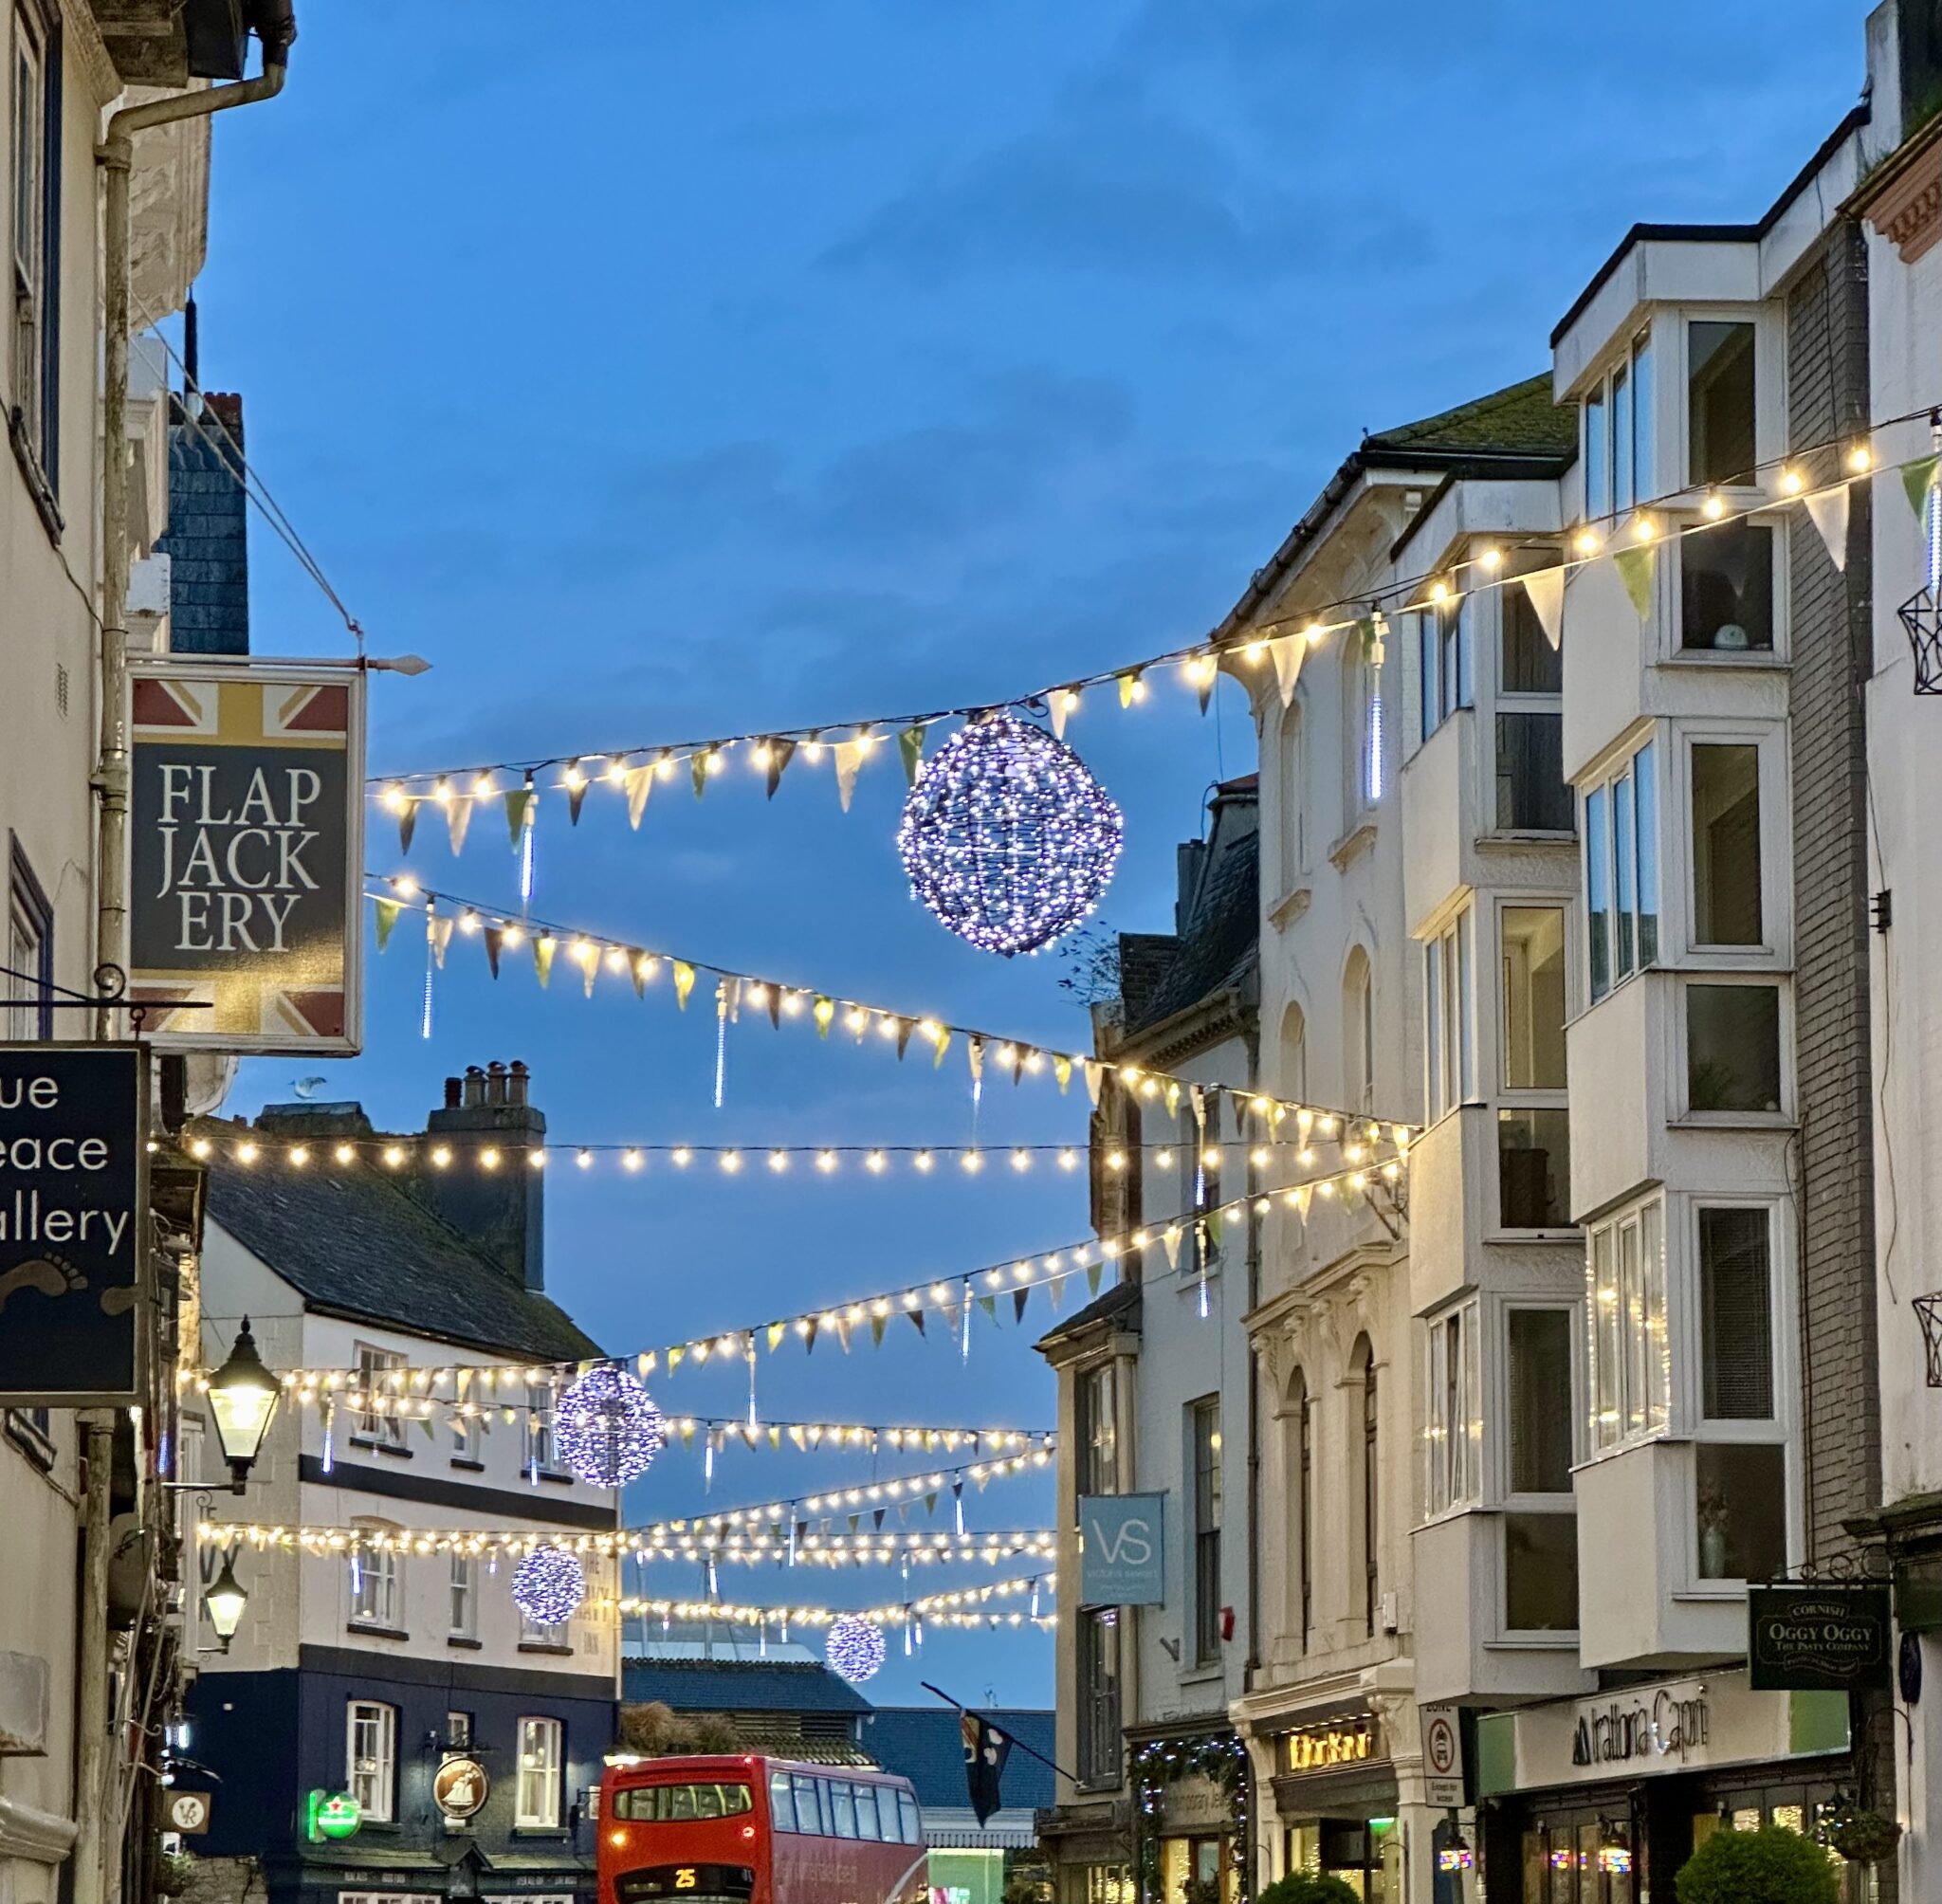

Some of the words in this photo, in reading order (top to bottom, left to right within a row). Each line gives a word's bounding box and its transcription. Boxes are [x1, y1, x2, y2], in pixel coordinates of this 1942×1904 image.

[157, 763, 321, 828] FLAP
[156, 826, 321, 899] JACK
[174, 891, 302, 952] ERY
[0, 1138, 108, 1170] ace
[0, 1190, 128, 1255] llery
[1792, 1604, 1846, 1618] CORNISH
[675, 1869, 696, 1888] 25
